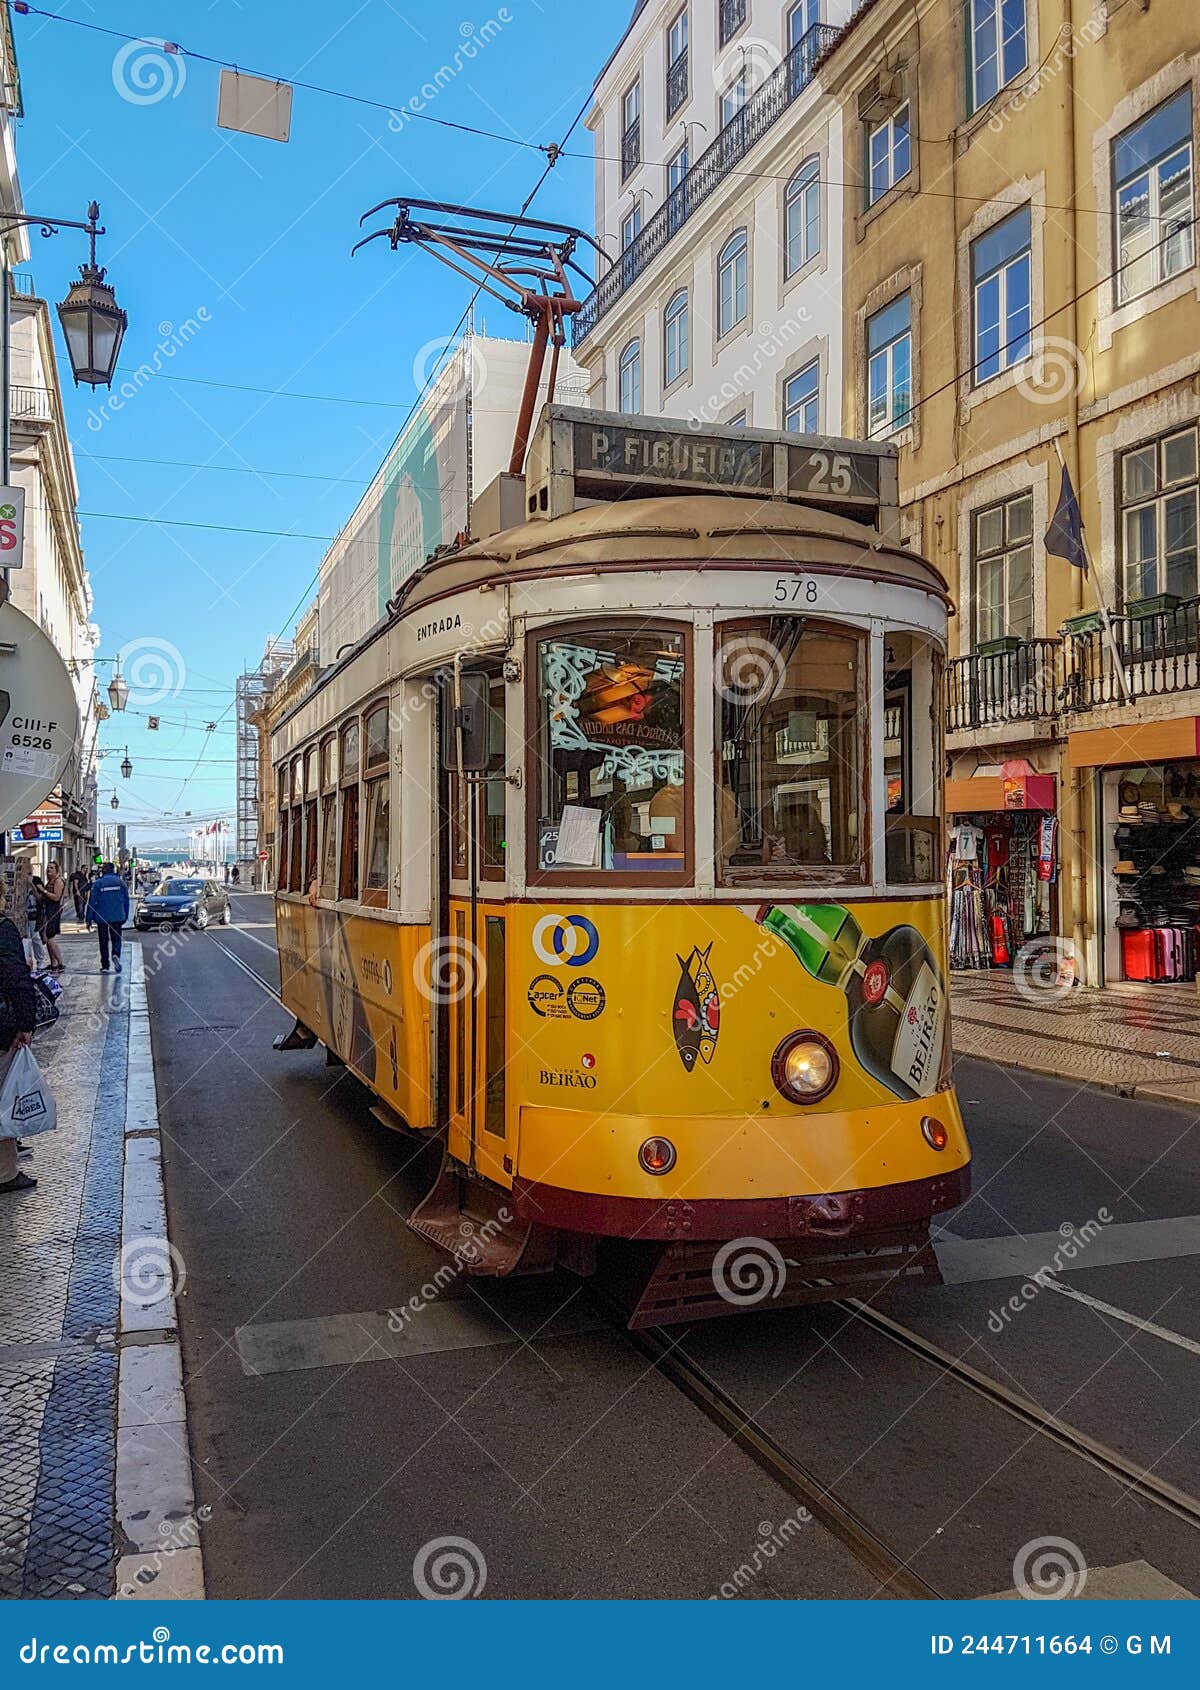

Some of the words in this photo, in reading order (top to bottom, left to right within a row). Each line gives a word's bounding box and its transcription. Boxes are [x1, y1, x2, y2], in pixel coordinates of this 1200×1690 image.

[591, 432, 611, 464] P.
[807, 452, 852, 495] 25
[774, 579, 818, 603] 578
[417, 613, 462, 642] ENTRADA
[12, 716, 57, 733] CIII-F
[11, 734, 52, 750] 6526
[908, 985, 940, 1086] BEIRÃO
[539, 1070, 597, 1089] BEIRÃO
